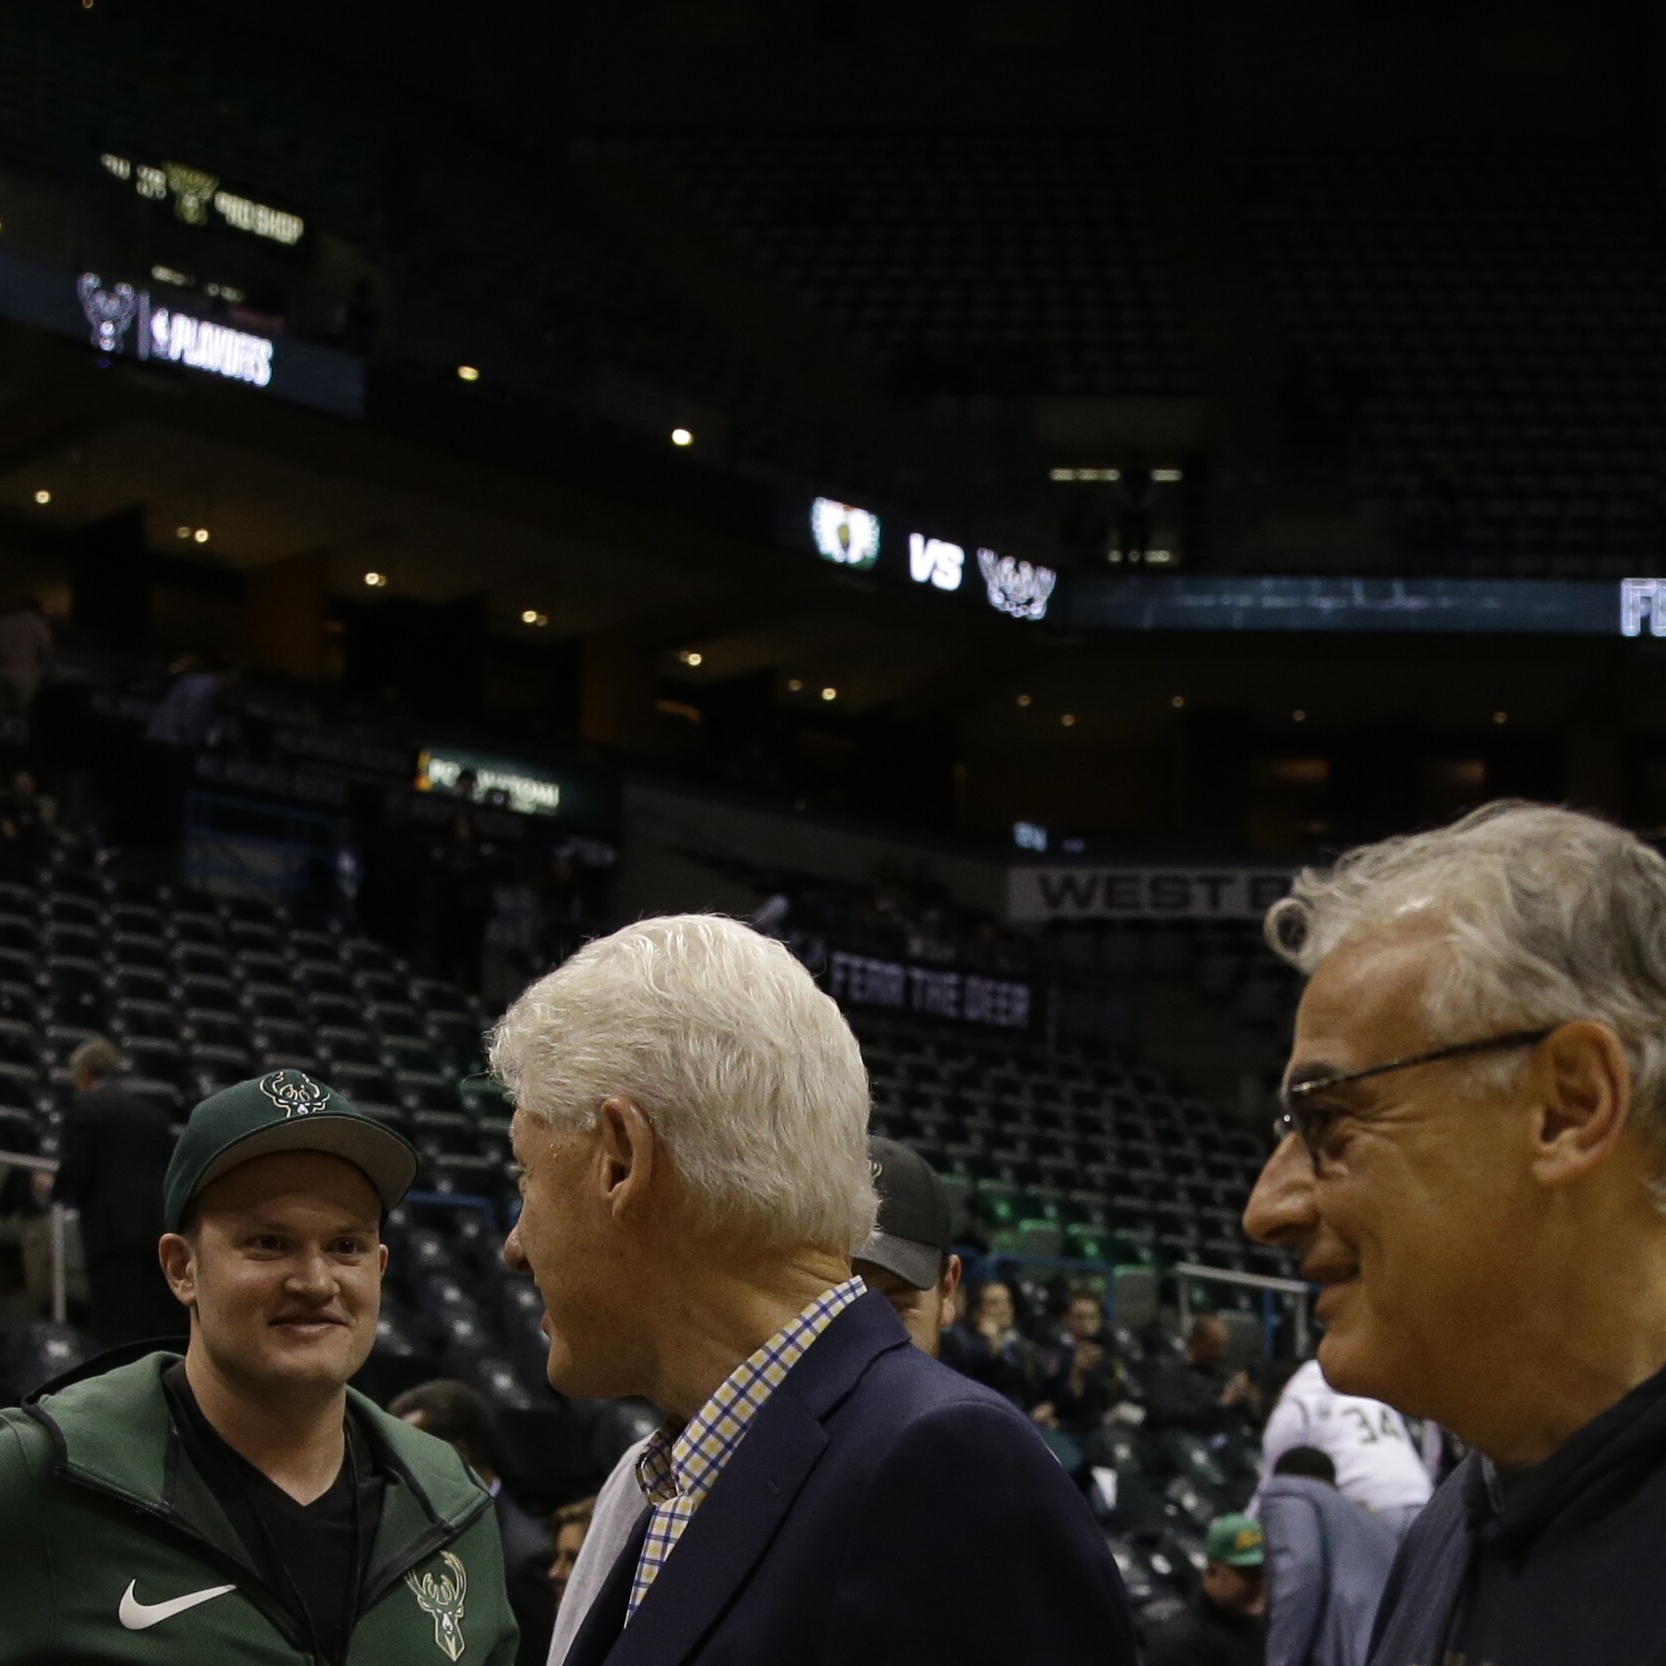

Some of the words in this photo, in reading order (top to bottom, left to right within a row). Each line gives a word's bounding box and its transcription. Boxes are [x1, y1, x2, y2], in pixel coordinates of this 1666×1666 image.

[909, 532, 965, 591] VS
[1036, 873, 1233, 910] WEST
[830, 949, 906, 1009] FEAR
